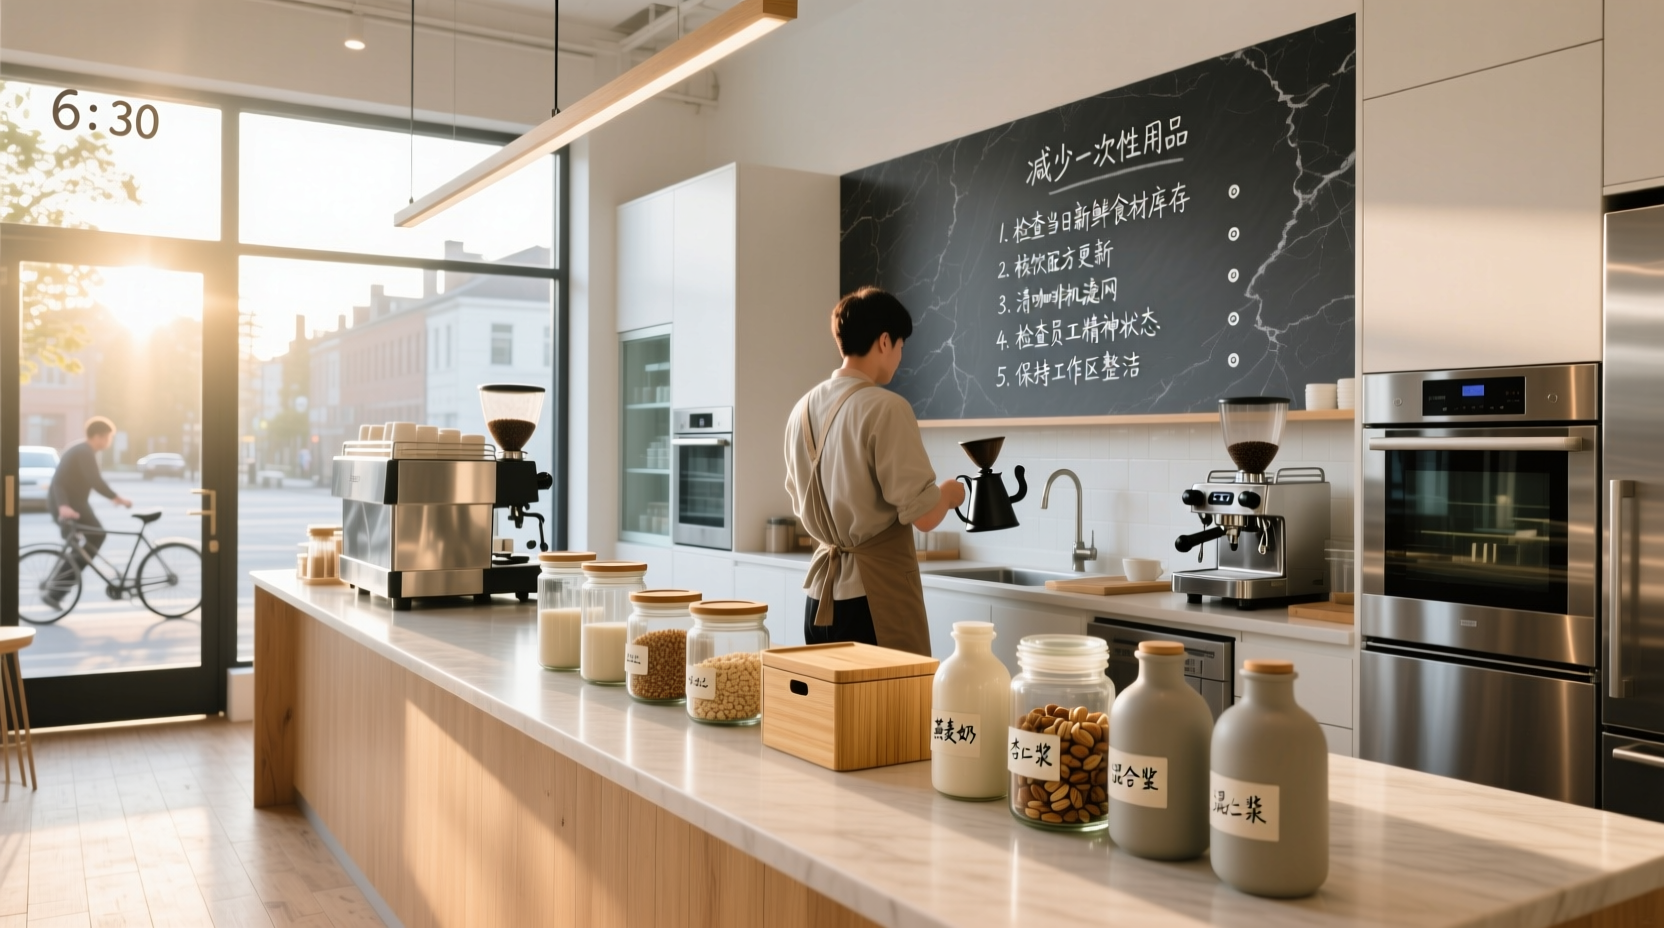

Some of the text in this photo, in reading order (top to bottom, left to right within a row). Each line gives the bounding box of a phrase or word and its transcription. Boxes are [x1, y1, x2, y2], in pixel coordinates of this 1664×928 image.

[52, 88, 160, 140] 6:30
[1025, 115, 1189, 187] 减少一次性用品
[1012, 182, 1191, 244] 检查当日新鲜食材库存
[997, 261, 1010, 279] 2.
[997, 294, 1011, 315] 3.
[996, 306, 1161, 351] 4. 检查员工精神状态
[996, 350, 1140, 388] 5. 保持工作区整洁
